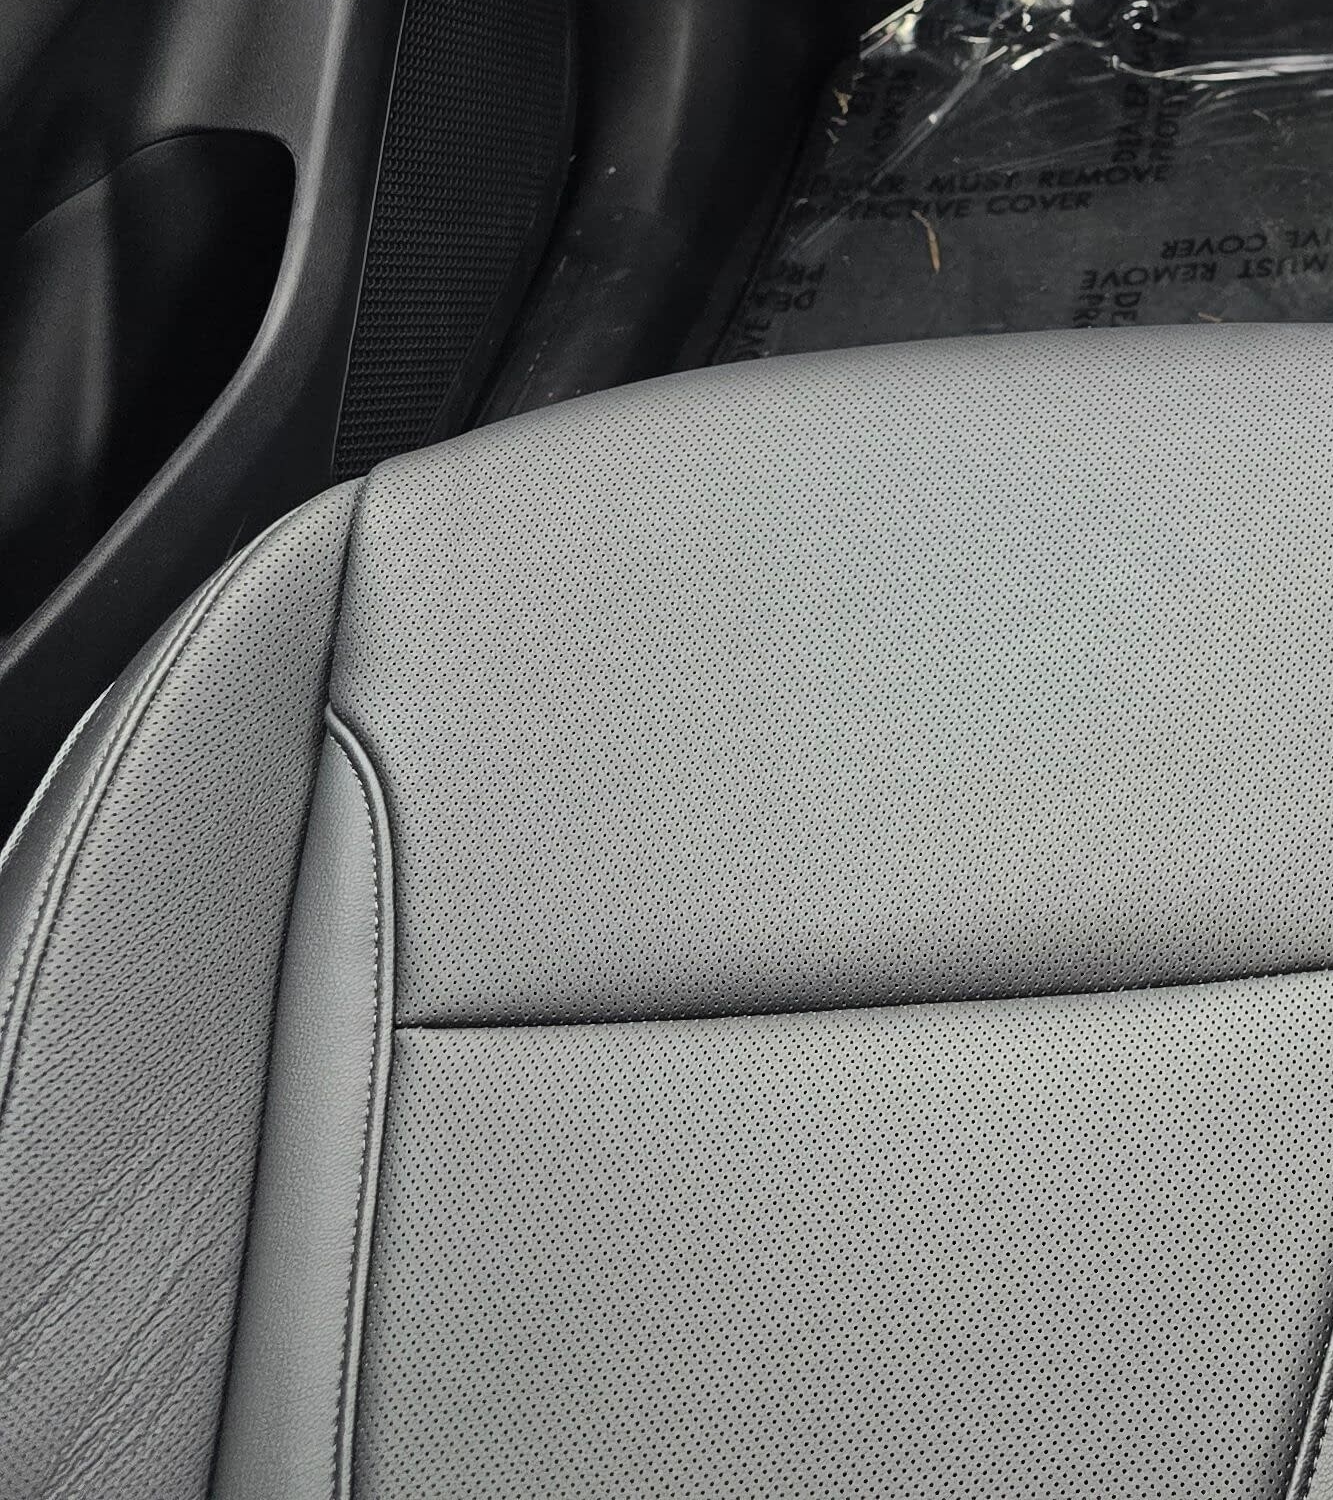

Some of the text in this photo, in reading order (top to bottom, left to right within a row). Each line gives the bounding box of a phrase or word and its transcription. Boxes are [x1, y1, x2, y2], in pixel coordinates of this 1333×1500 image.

[927, 171, 1021, 196] MUST
[1037, 163, 1171, 190] REMOVE
[985, 191, 1094, 217] COVER
[1160, 232, 1268, 261] COVER
[1080, 261, 1217, 292] REMOVE
[1236, 252, 1329, 280] MUST
